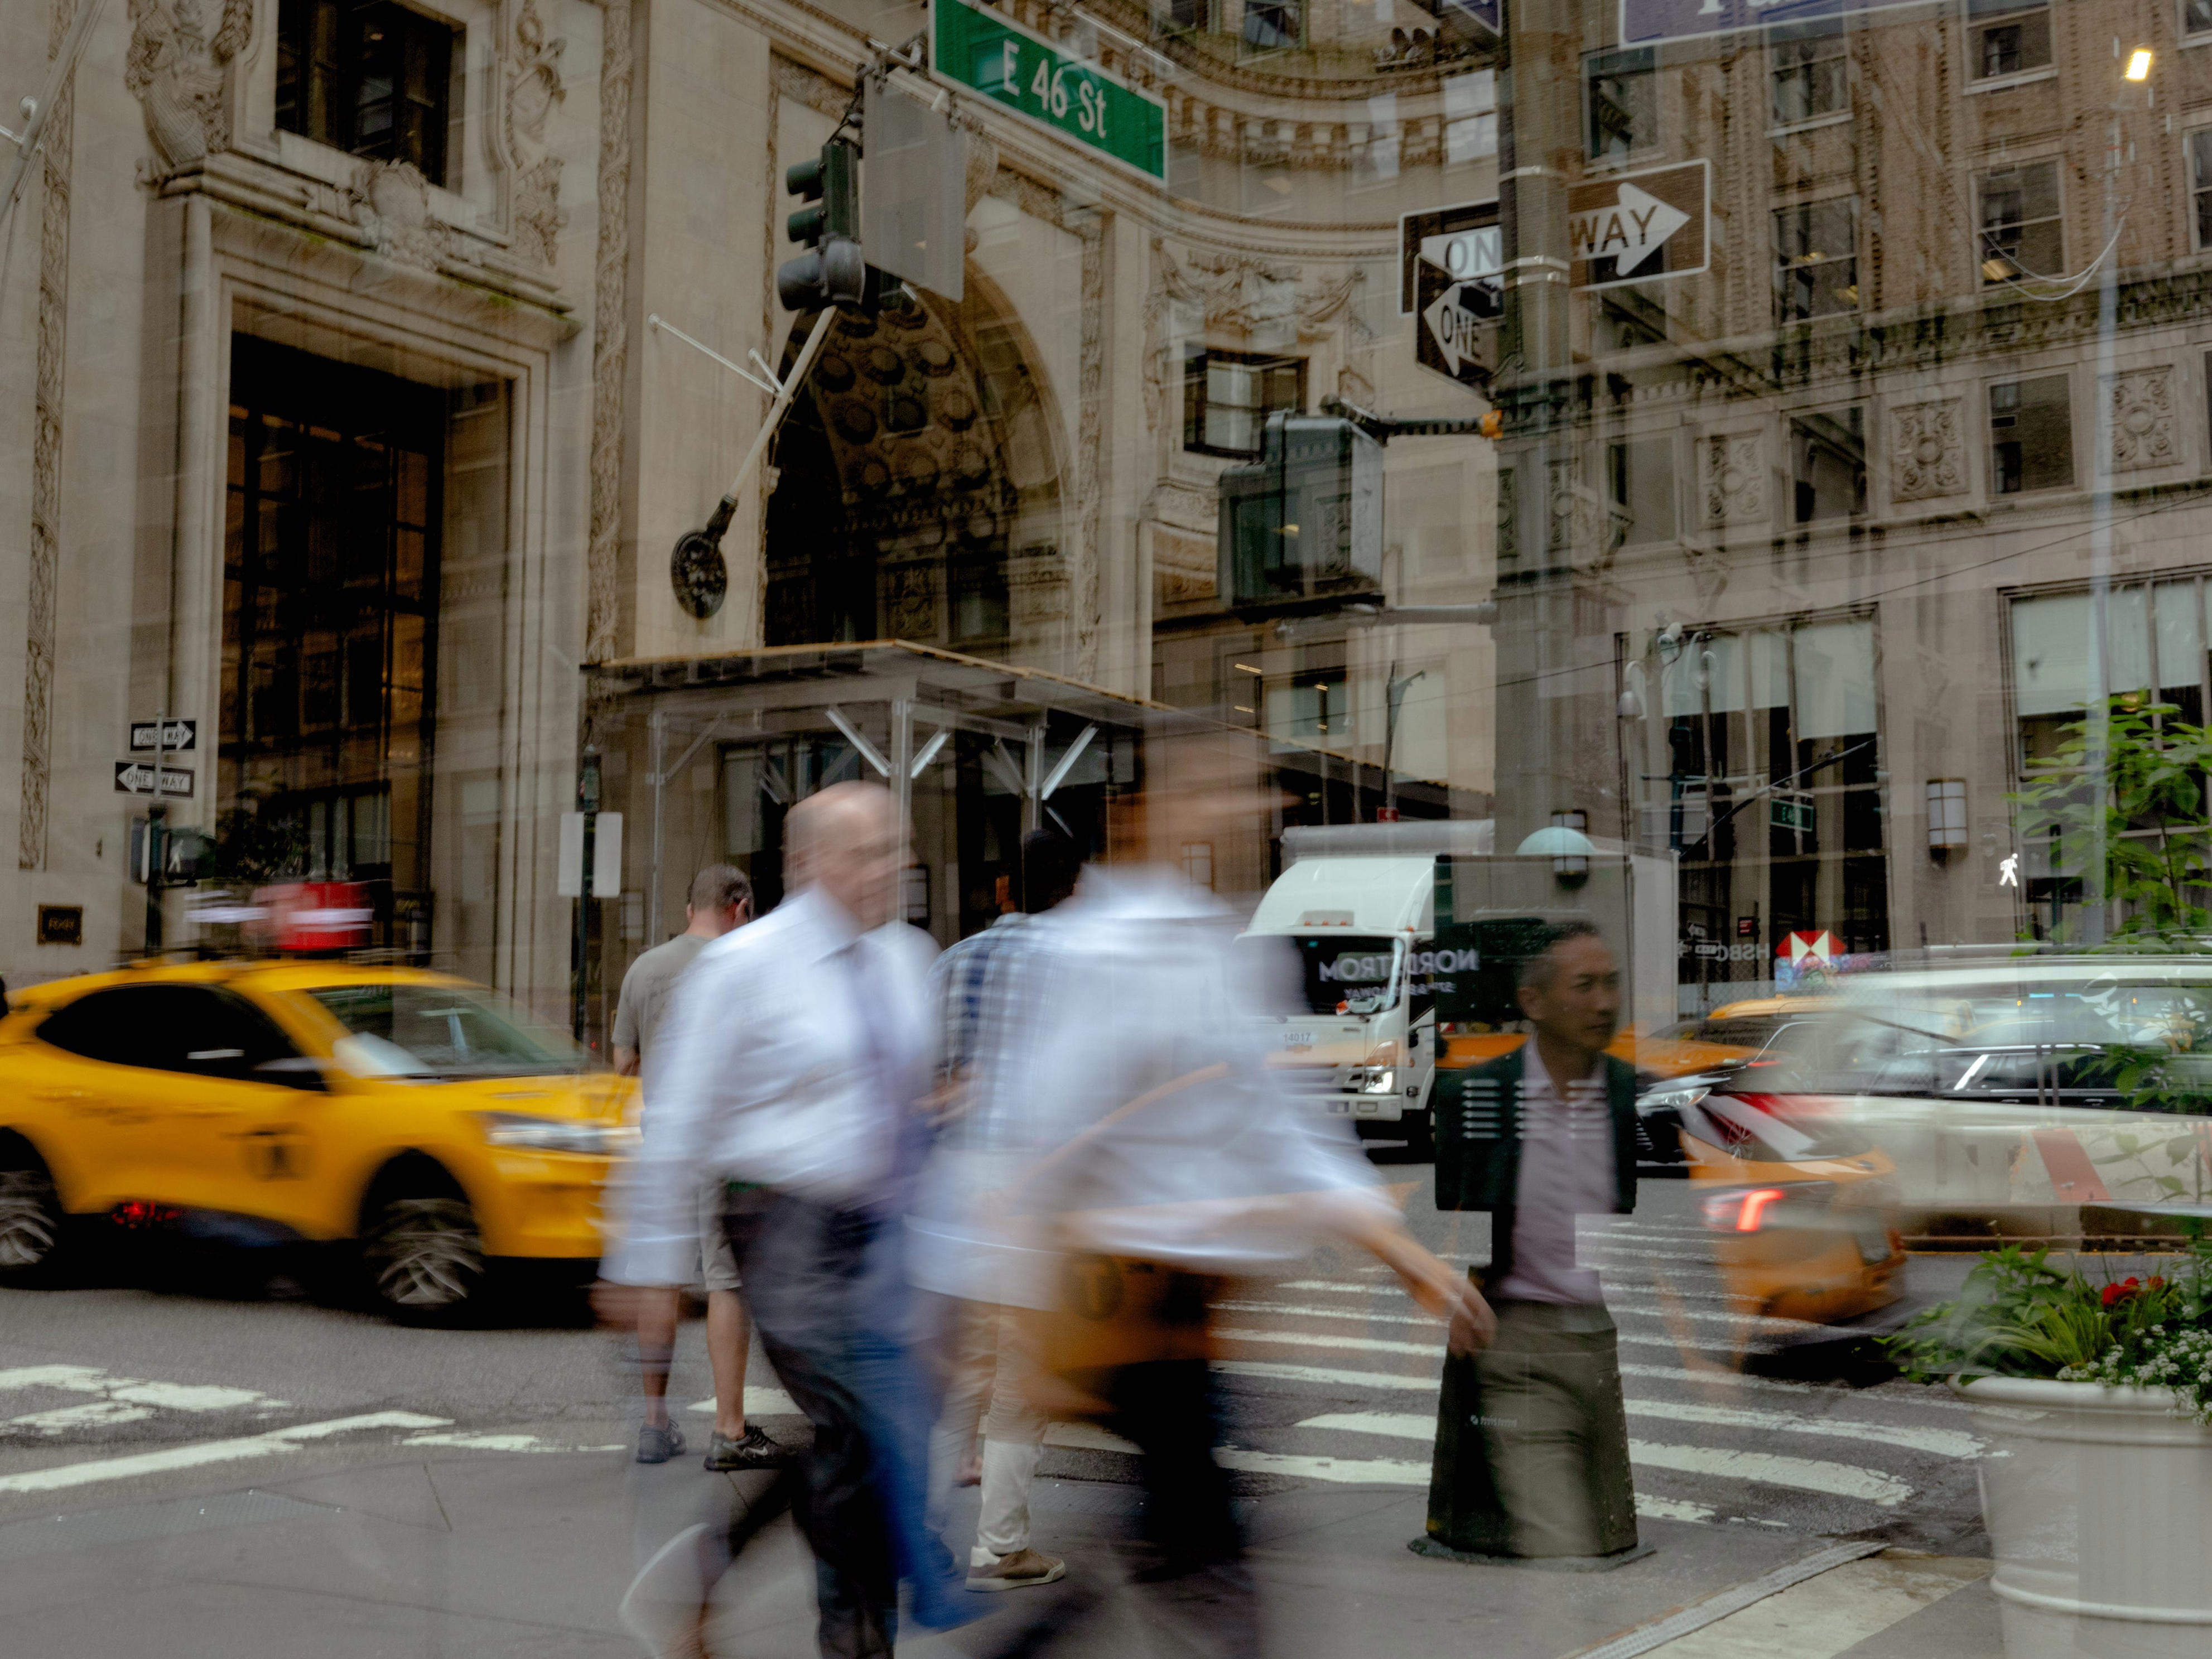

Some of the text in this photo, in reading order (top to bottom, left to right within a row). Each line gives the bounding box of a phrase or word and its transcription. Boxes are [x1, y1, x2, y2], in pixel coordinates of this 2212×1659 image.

[1003, 38, 1107, 138] E 46 St
[1445, 205, 1657, 273] ON WAY
[1442, 305, 1481, 360] ONE
[139, 727, 188, 745] ONE WAY
[126, 771, 185, 790] ONE WAY
[1284, 1033, 1311, 1041] 14017
